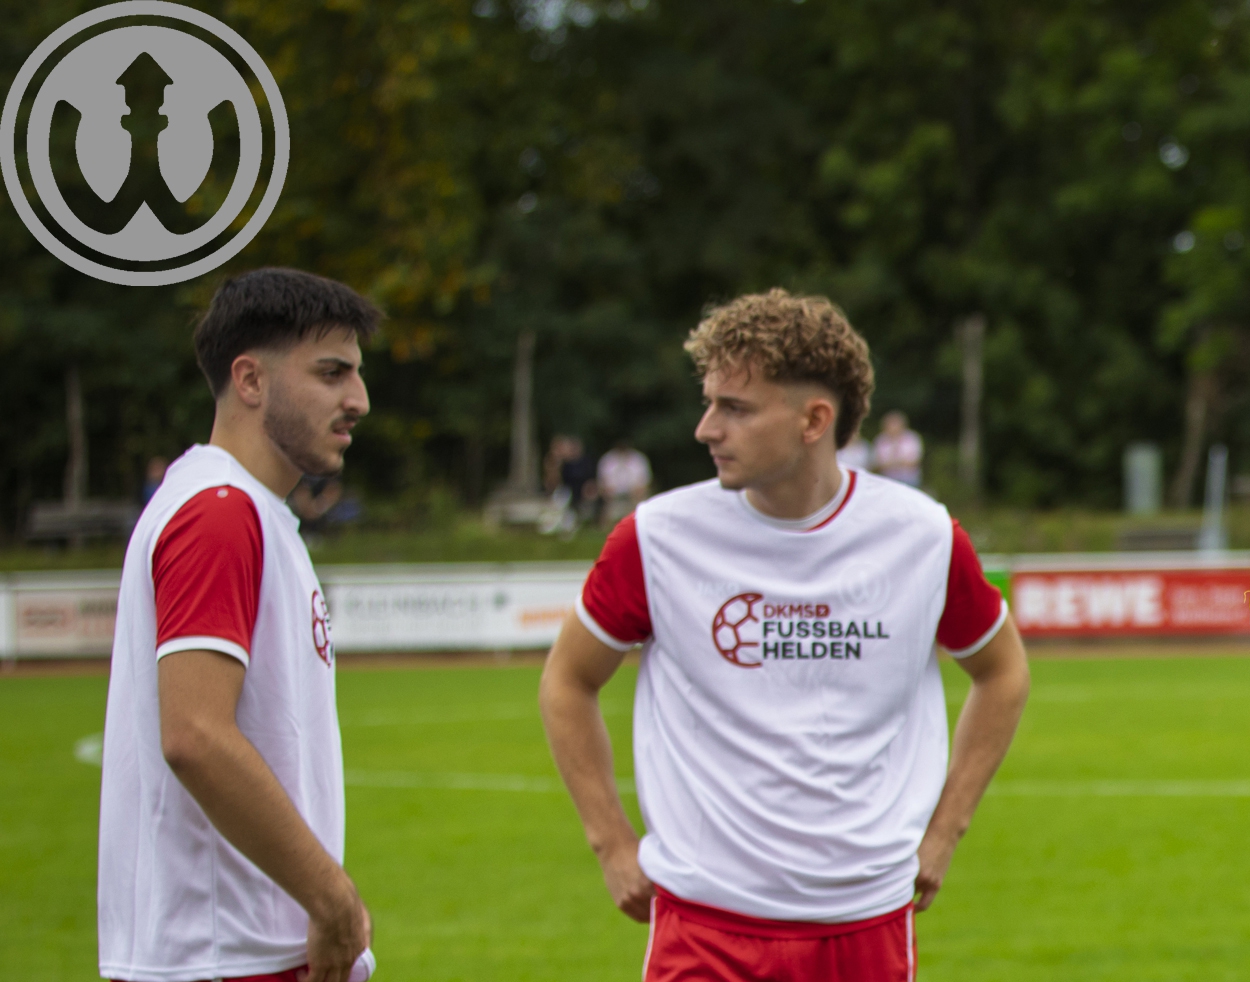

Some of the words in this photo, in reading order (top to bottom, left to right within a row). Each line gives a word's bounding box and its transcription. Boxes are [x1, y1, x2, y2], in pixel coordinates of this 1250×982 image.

[763, 604, 814, 618] DKMS
[762, 620, 890, 639] FUSSBALL
[762, 641, 861, 660] HELDEN
